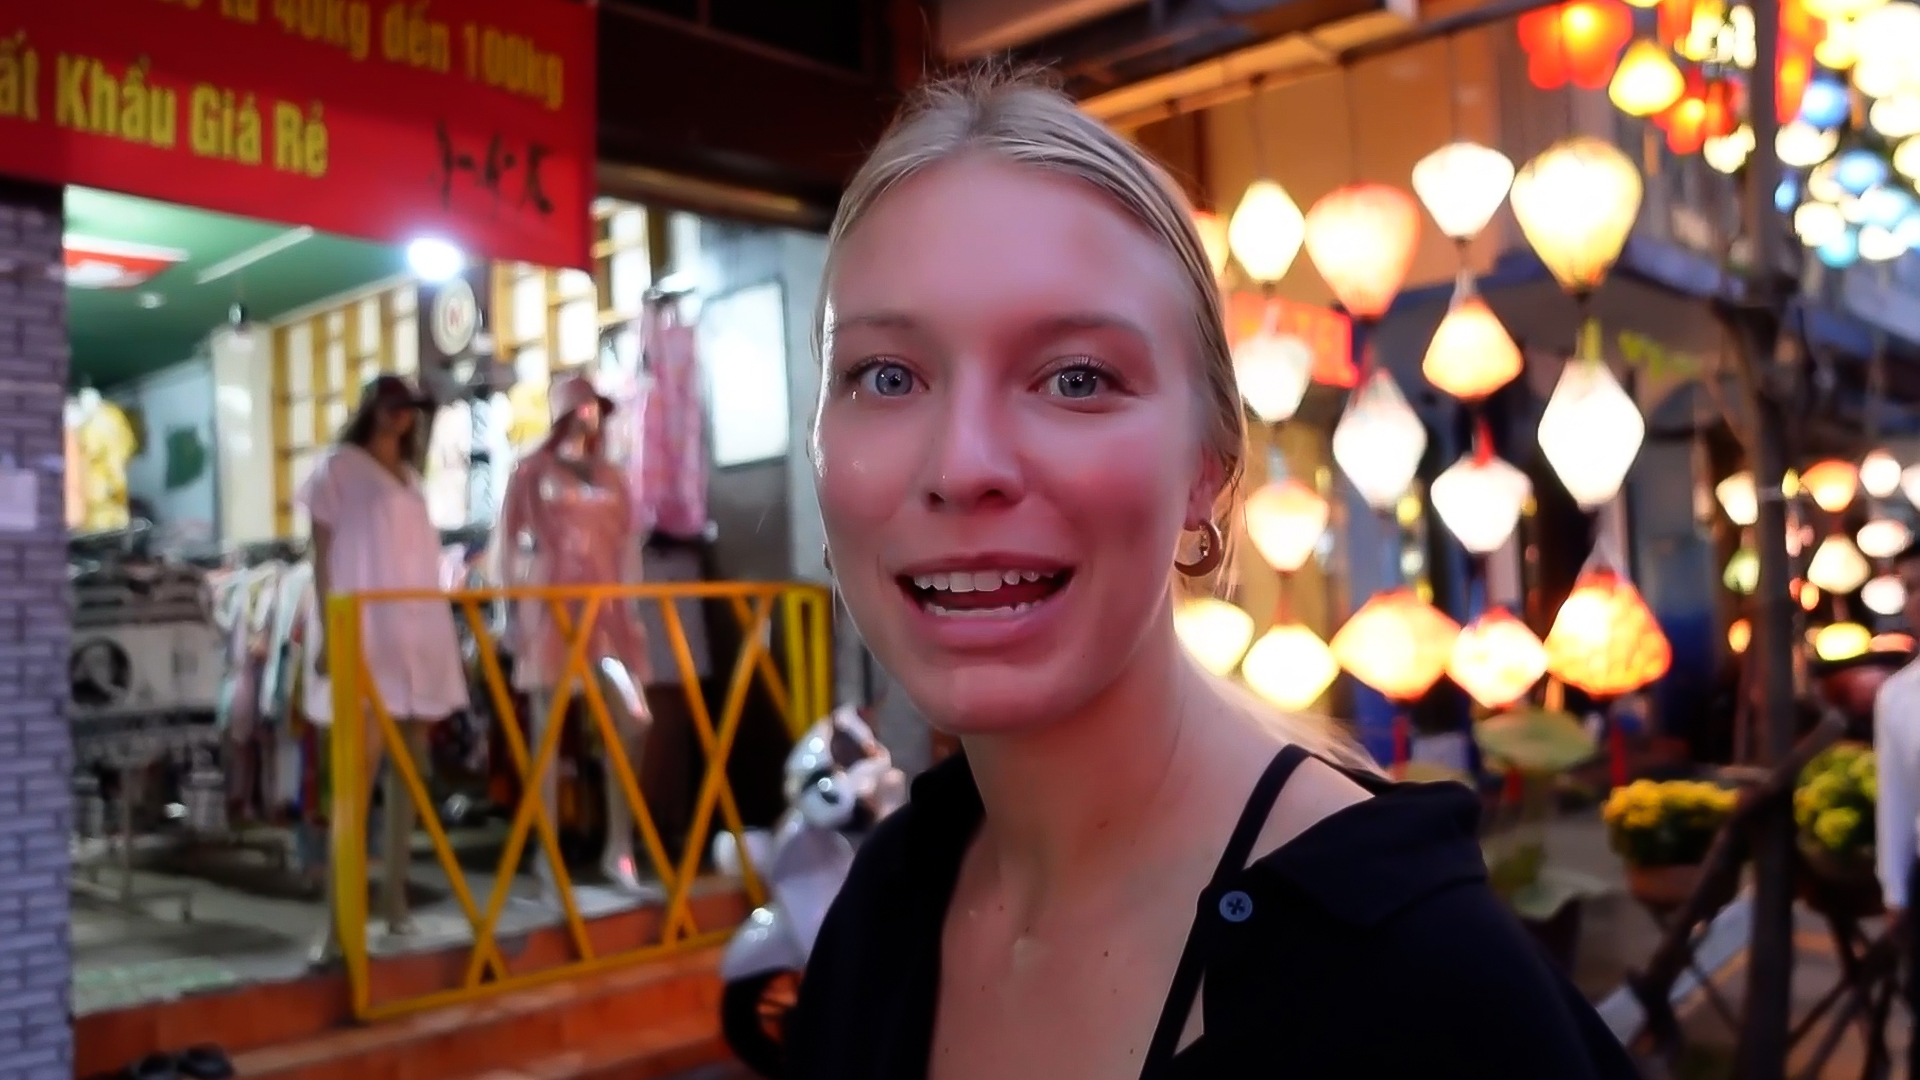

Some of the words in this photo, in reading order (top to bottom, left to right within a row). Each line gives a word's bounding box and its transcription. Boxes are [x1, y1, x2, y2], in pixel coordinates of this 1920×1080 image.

[56, 53, 177, 148] Khẩu
[191, 82, 262, 166] Giá
[273, 99, 328, 178] Rẻ
[463, 22, 563, 110] 100kg
